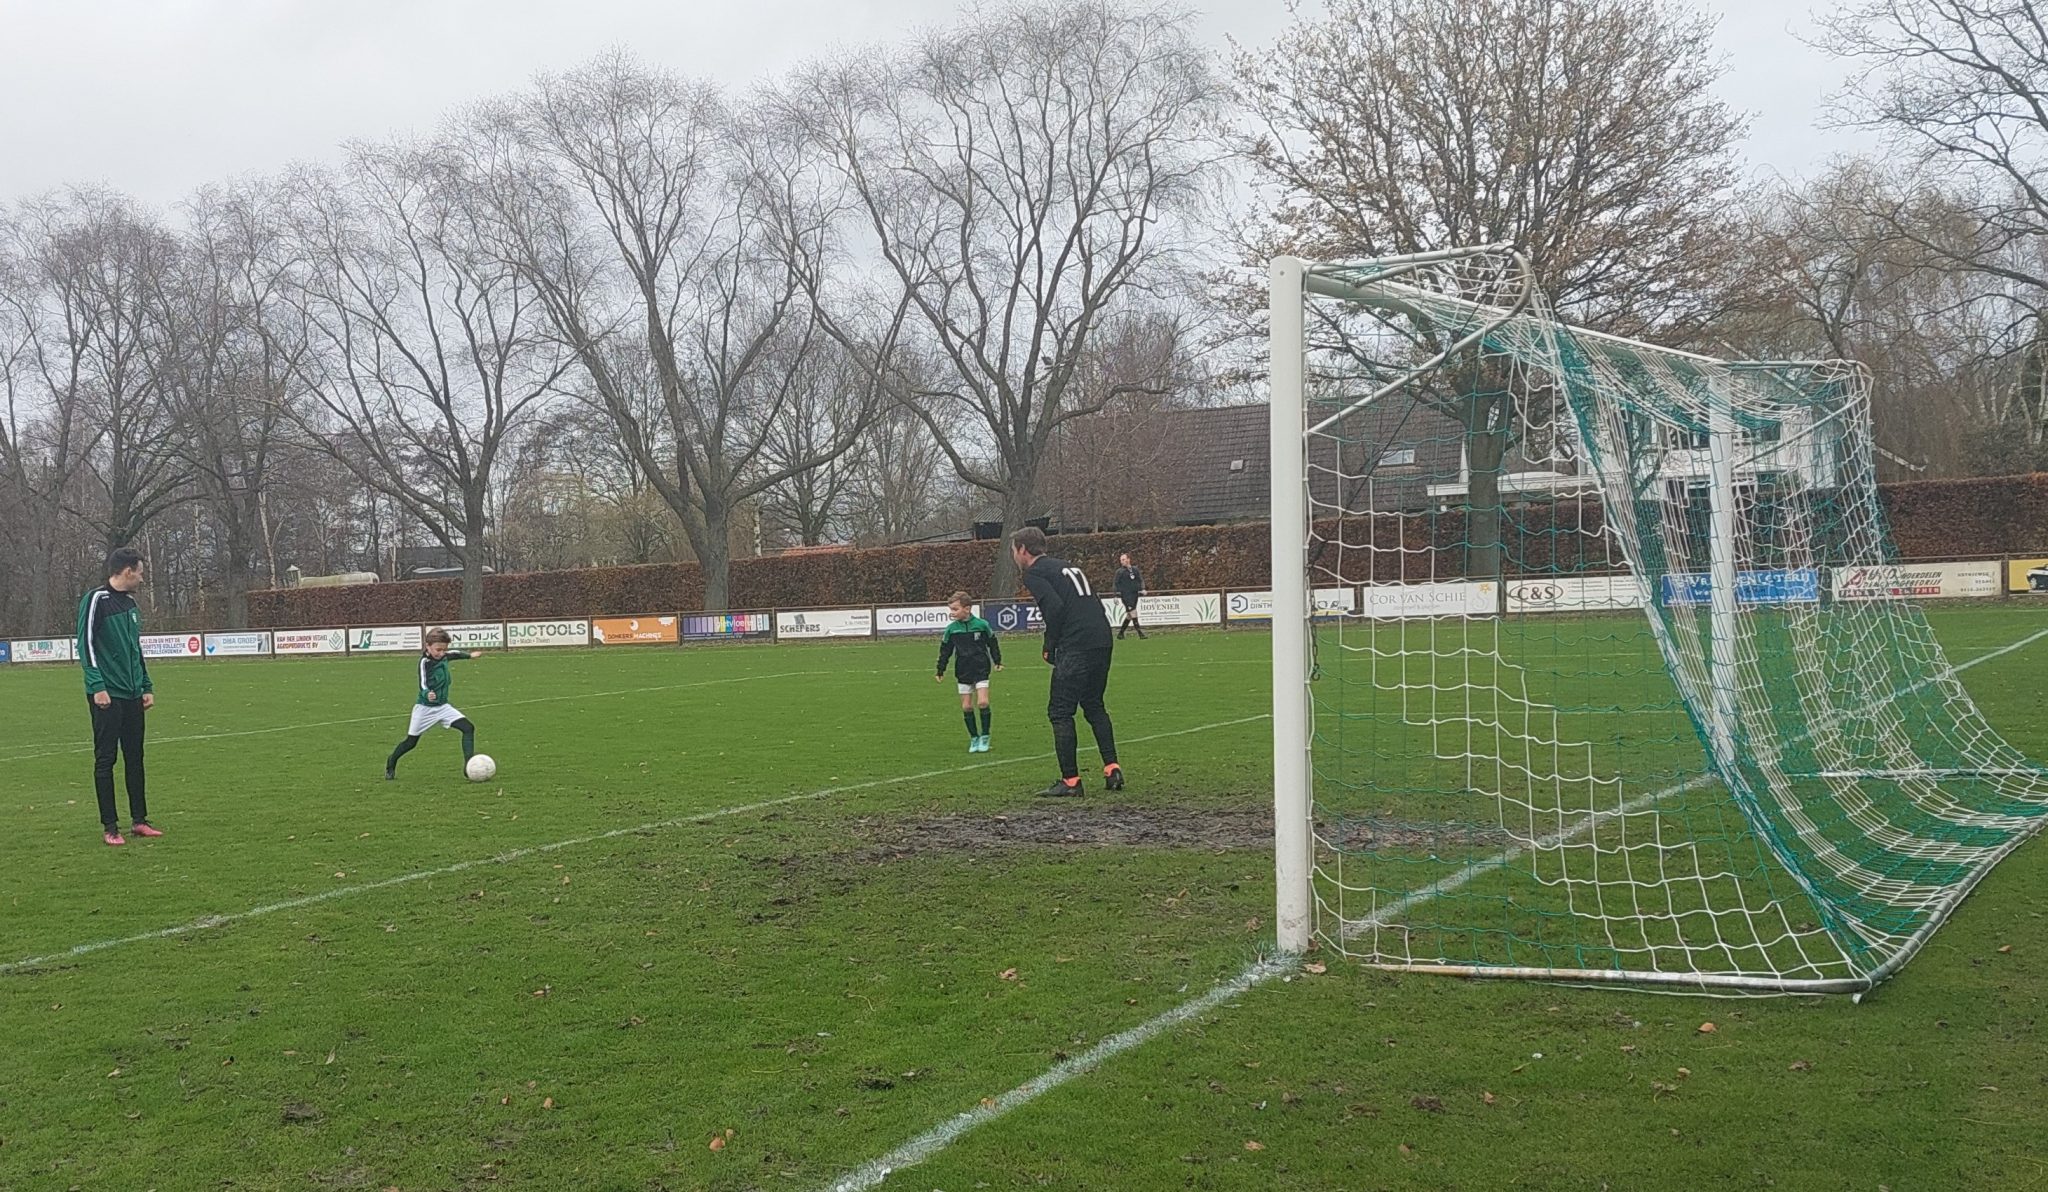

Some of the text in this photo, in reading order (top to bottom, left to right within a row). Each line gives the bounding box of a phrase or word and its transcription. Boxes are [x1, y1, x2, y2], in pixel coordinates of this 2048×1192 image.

[1369, 594, 1397, 605] COR
[1400, 593, 1424, 604] VAN
[1518, 586, 1554, 600] C&S
[509, 623, 586, 637] BJCTOOLS
[780, 624, 820, 633] SCHEPERS
